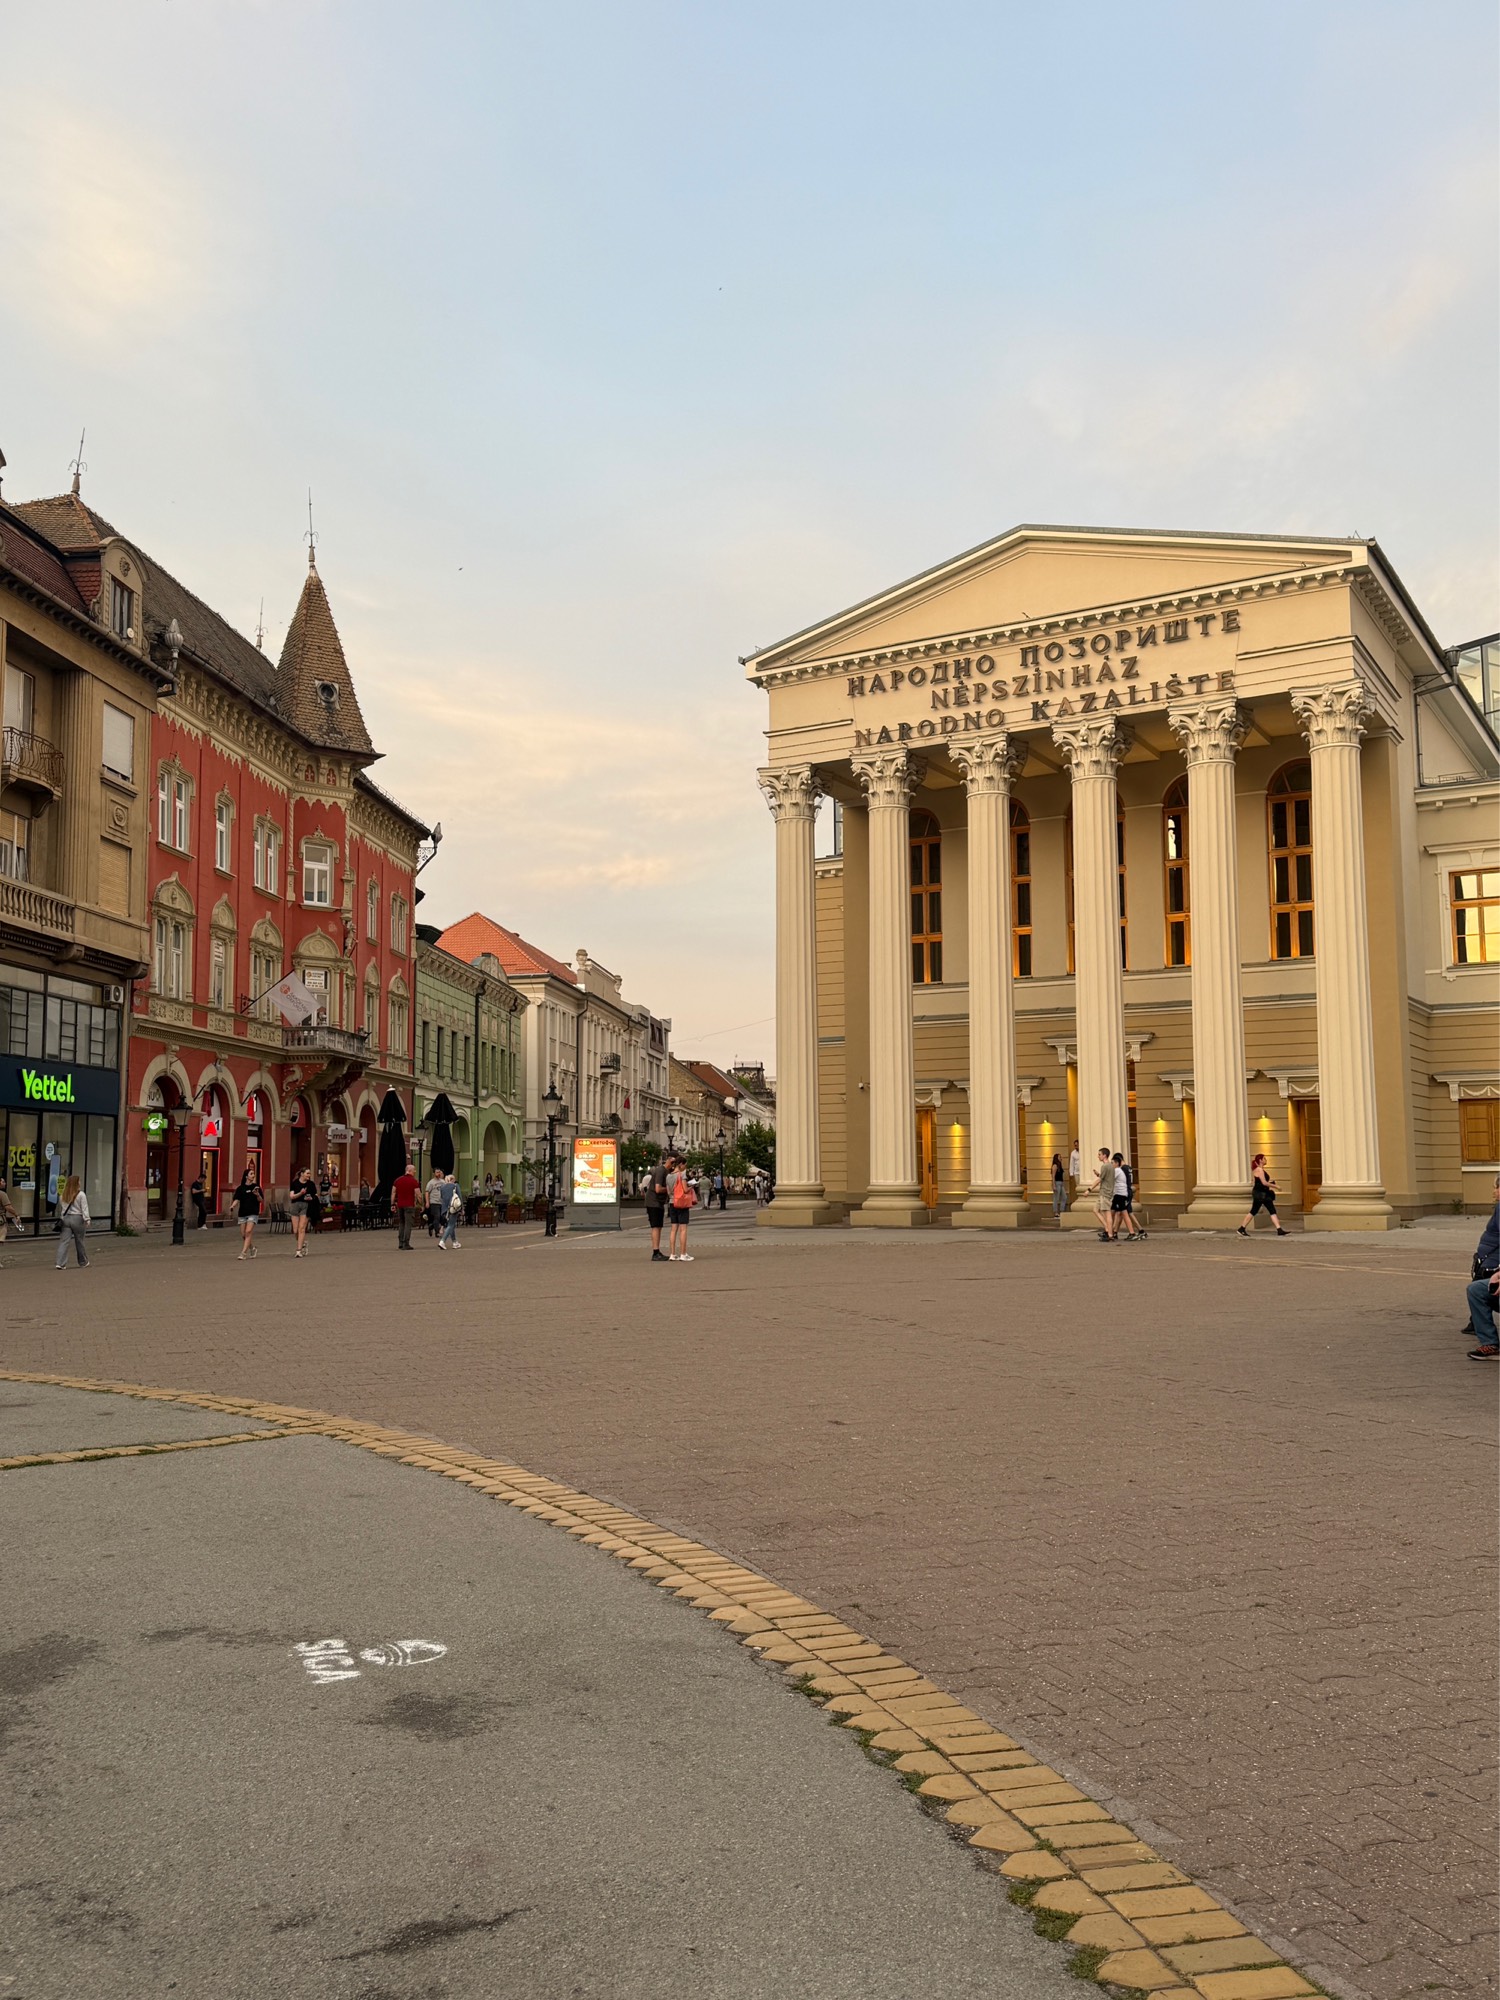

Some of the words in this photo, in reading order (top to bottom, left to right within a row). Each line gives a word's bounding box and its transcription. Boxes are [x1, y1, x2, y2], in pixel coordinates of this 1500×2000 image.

[847, 654, 995, 697] НАРОДНО
[1019, 609, 1241, 667] ПОЗОРИШТЕ
[931, 655, 1140, 709] NÉPSZÍNHÁZ
[855, 708, 1005, 748] NARODNO
[1030, 670, 1235, 721] KAZALIŠTE
[332, 1131, 347, 1141] mts
